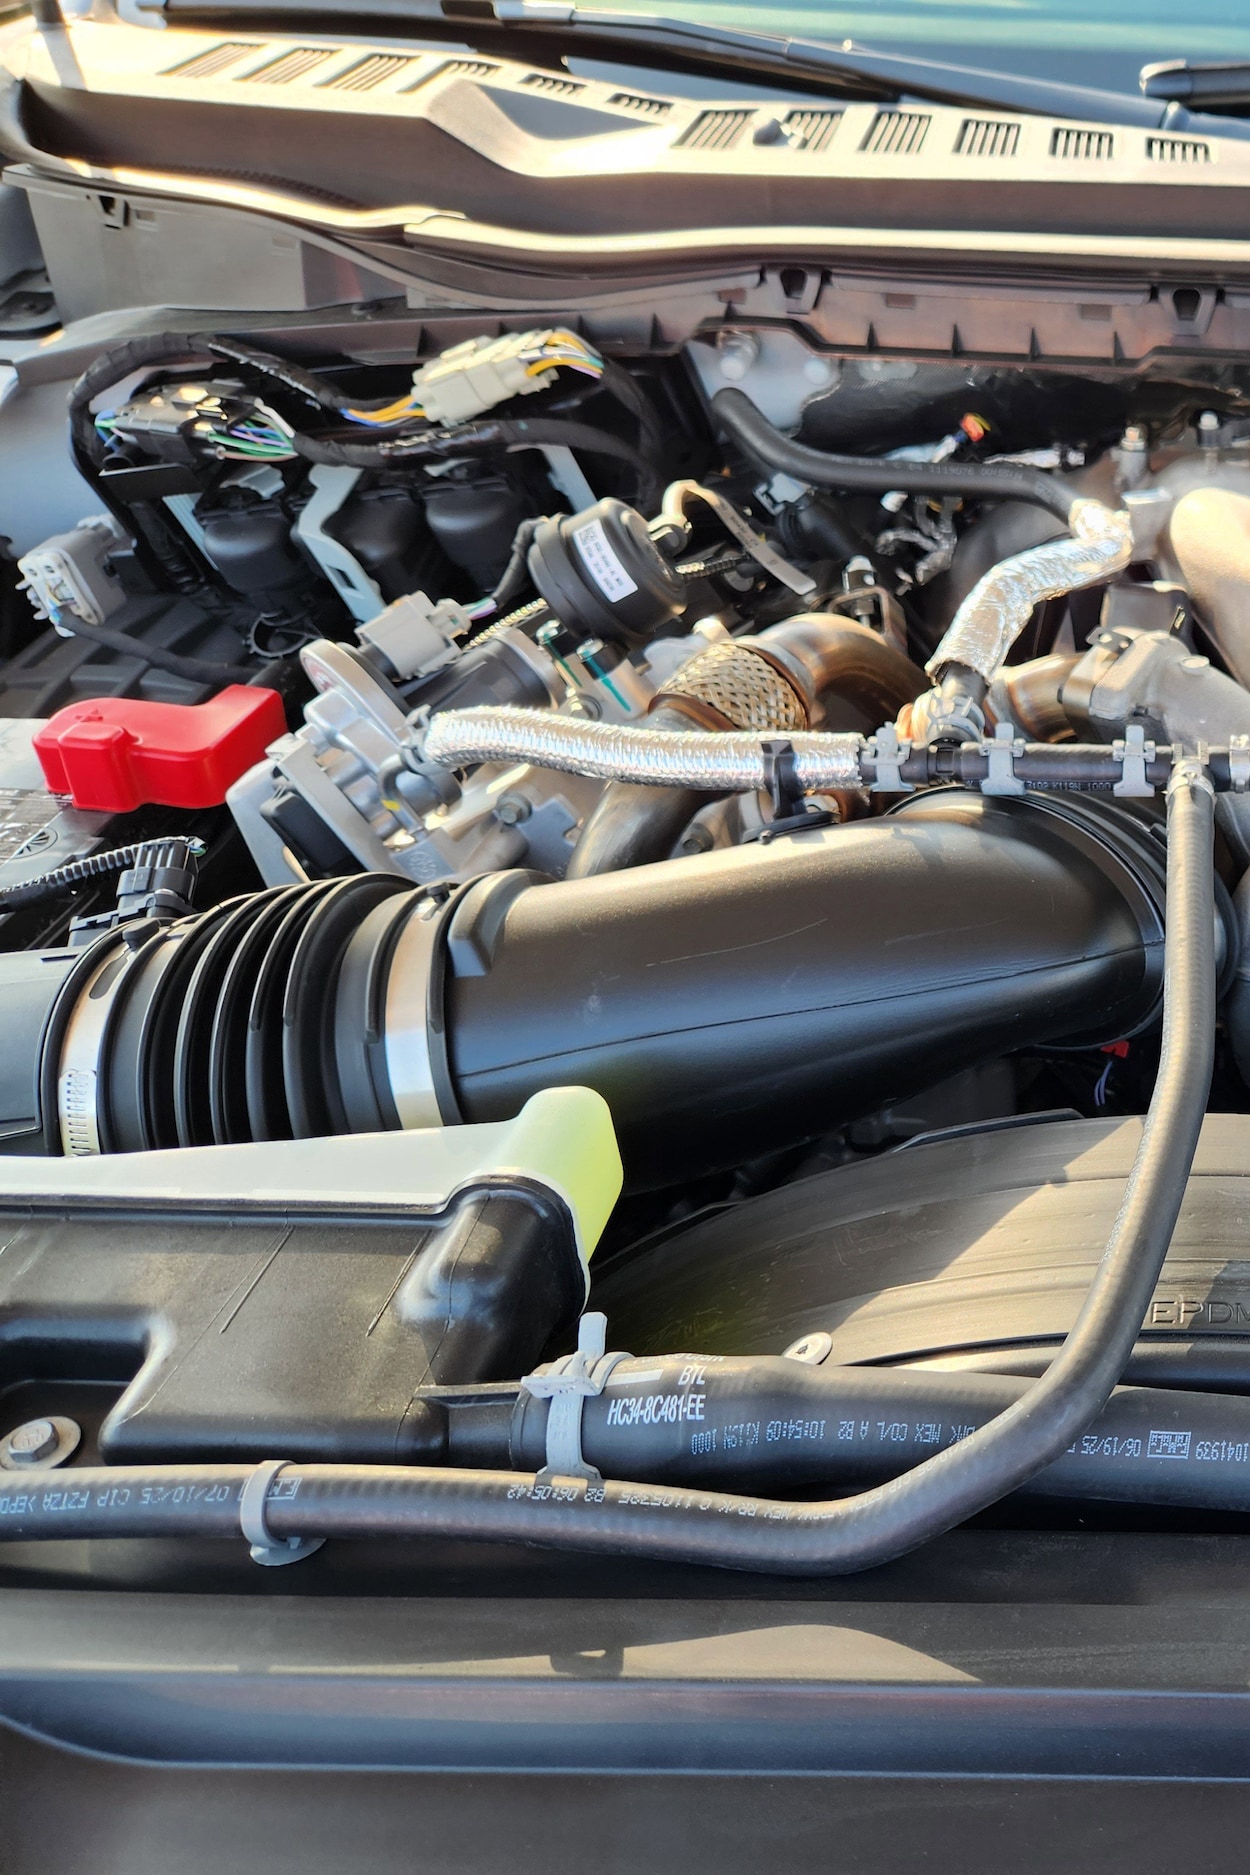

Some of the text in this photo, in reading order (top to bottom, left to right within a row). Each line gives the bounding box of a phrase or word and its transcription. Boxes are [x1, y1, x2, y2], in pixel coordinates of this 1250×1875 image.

[677, 1364, 708, 1387] BTL
[606, 1393, 707, 1426] HC34-8C481-EE
[765, 1419, 826, 1442] 10:54:09
[837, 1420, 855, 1441] B2
[859, 1419, 870, 1440] A
[915, 1423, 942, 1443] MEX
[690, 1427, 718, 1456] 1000
[1081, 1434, 1142, 1458] 06/19/25
[1195, 1439, 1250, 1462] 1041939
[97, 1488, 131, 1508] CIP
[139, 1484, 231, 1505] 07/10/25
[506, 1483, 580, 1503] 06:05:42
[583, 1486, 608, 1505] B2
